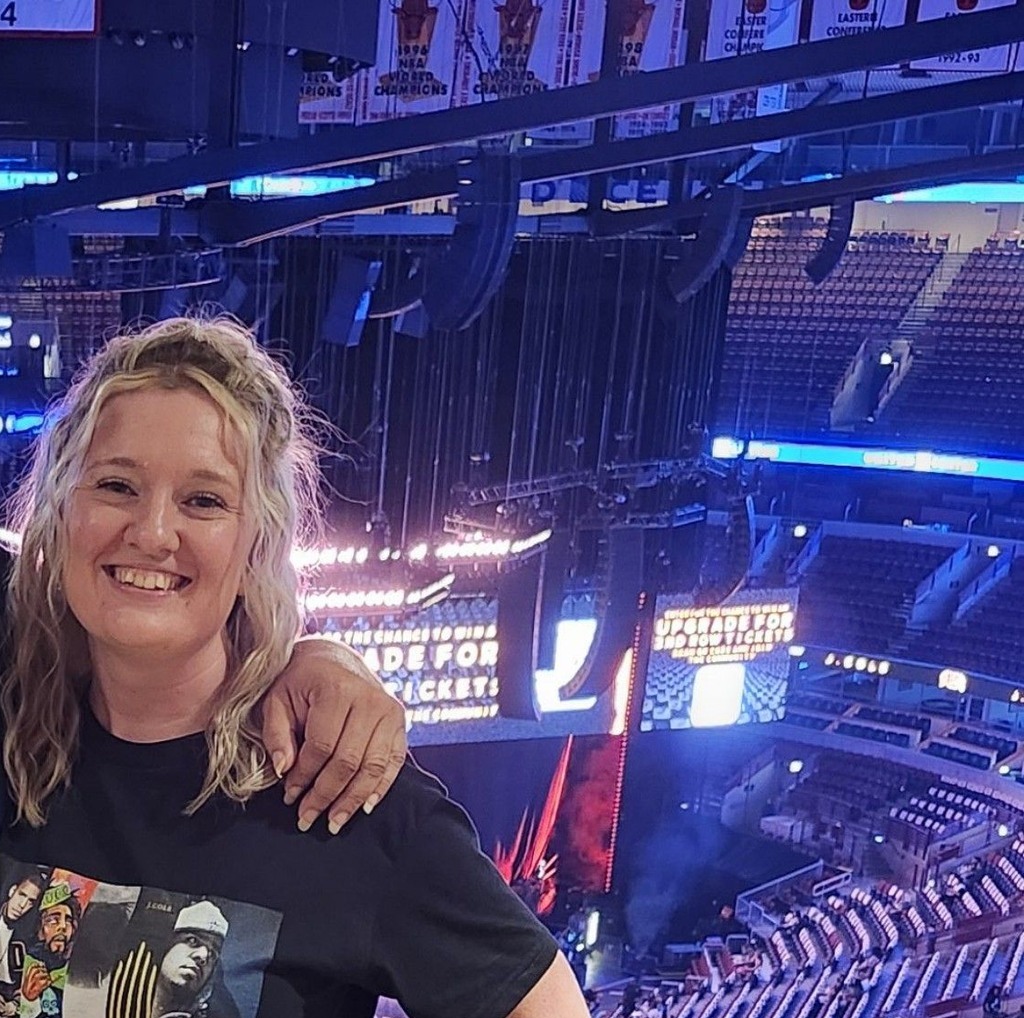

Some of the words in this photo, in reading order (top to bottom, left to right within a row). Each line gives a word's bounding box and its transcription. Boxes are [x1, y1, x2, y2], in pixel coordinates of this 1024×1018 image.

[374, 84, 448, 96] CHAMPIONS
[656, 615, 751, 636] UPGRADE
[754, 612, 794, 630] FOR
[432, 627, 453, 641] TO
[362, 645, 426, 672] ADE
[434, 641, 499, 670] FOR
